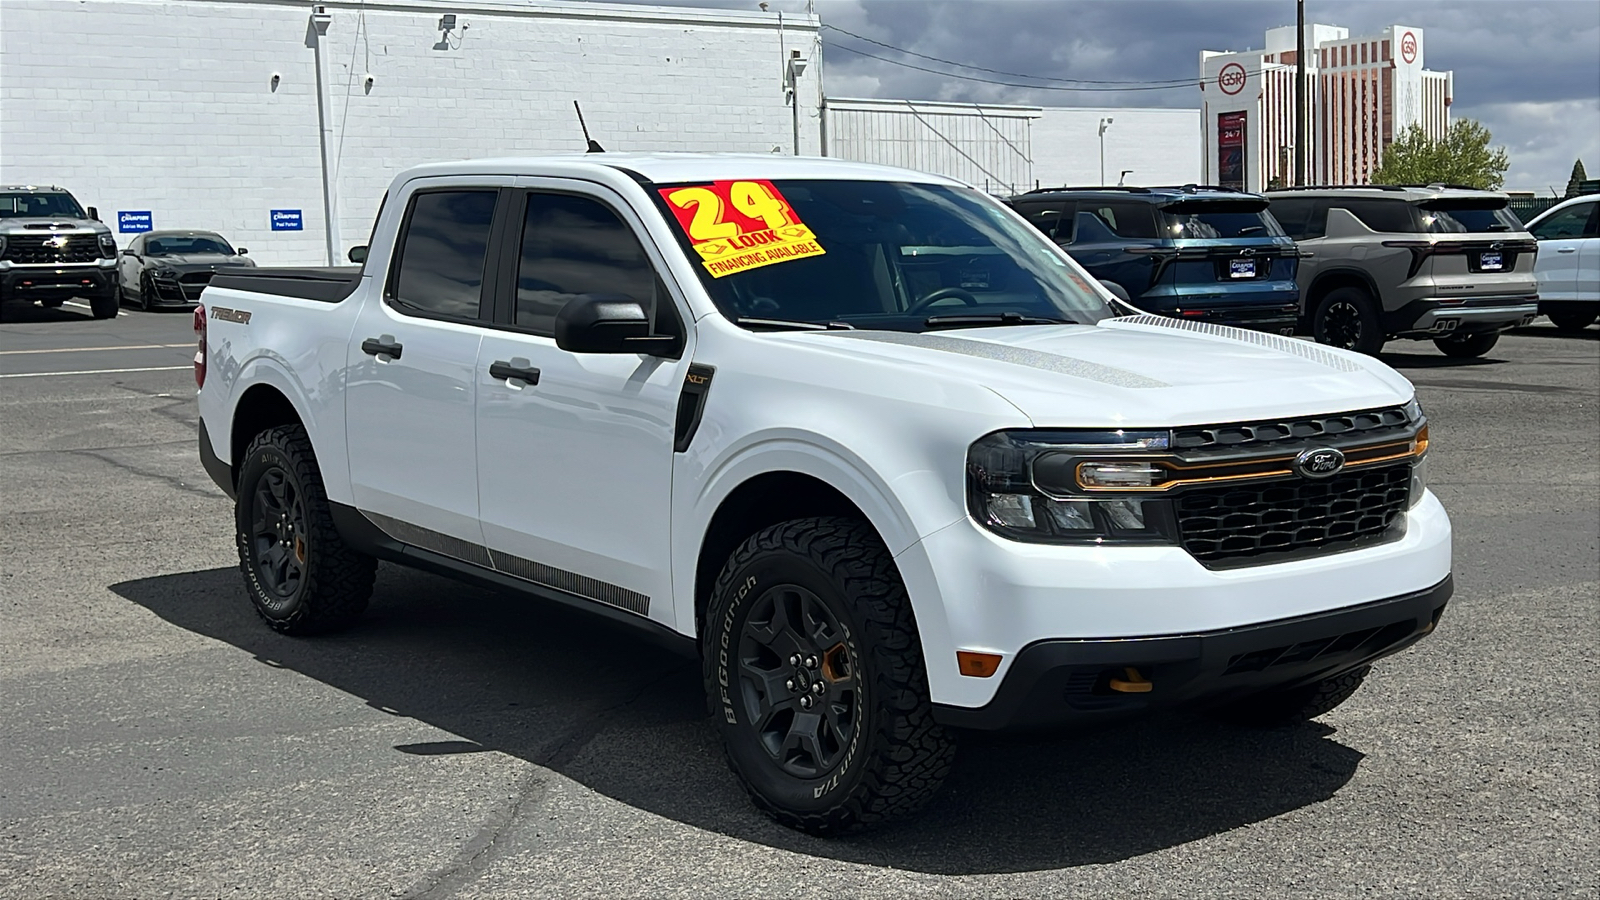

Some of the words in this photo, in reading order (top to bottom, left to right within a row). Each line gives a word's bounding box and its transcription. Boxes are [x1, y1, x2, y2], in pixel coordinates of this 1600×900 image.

[1222, 72, 1242, 86] GSR
[1225, 130, 1241, 139] 24/7
[668, 181, 795, 242] 24
[727, 229, 783, 251] LOOK
[709, 251, 767, 275] FINANCING
[767, 241, 821, 262] AVAILABLE
[210, 305, 252, 325] TREMOR
[686, 374, 709, 385] XLT
[1311, 454, 1337, 472] Ford
[718, 574, 757, 725] BFGoodrich
[813, 774, 840, 799] T/A
